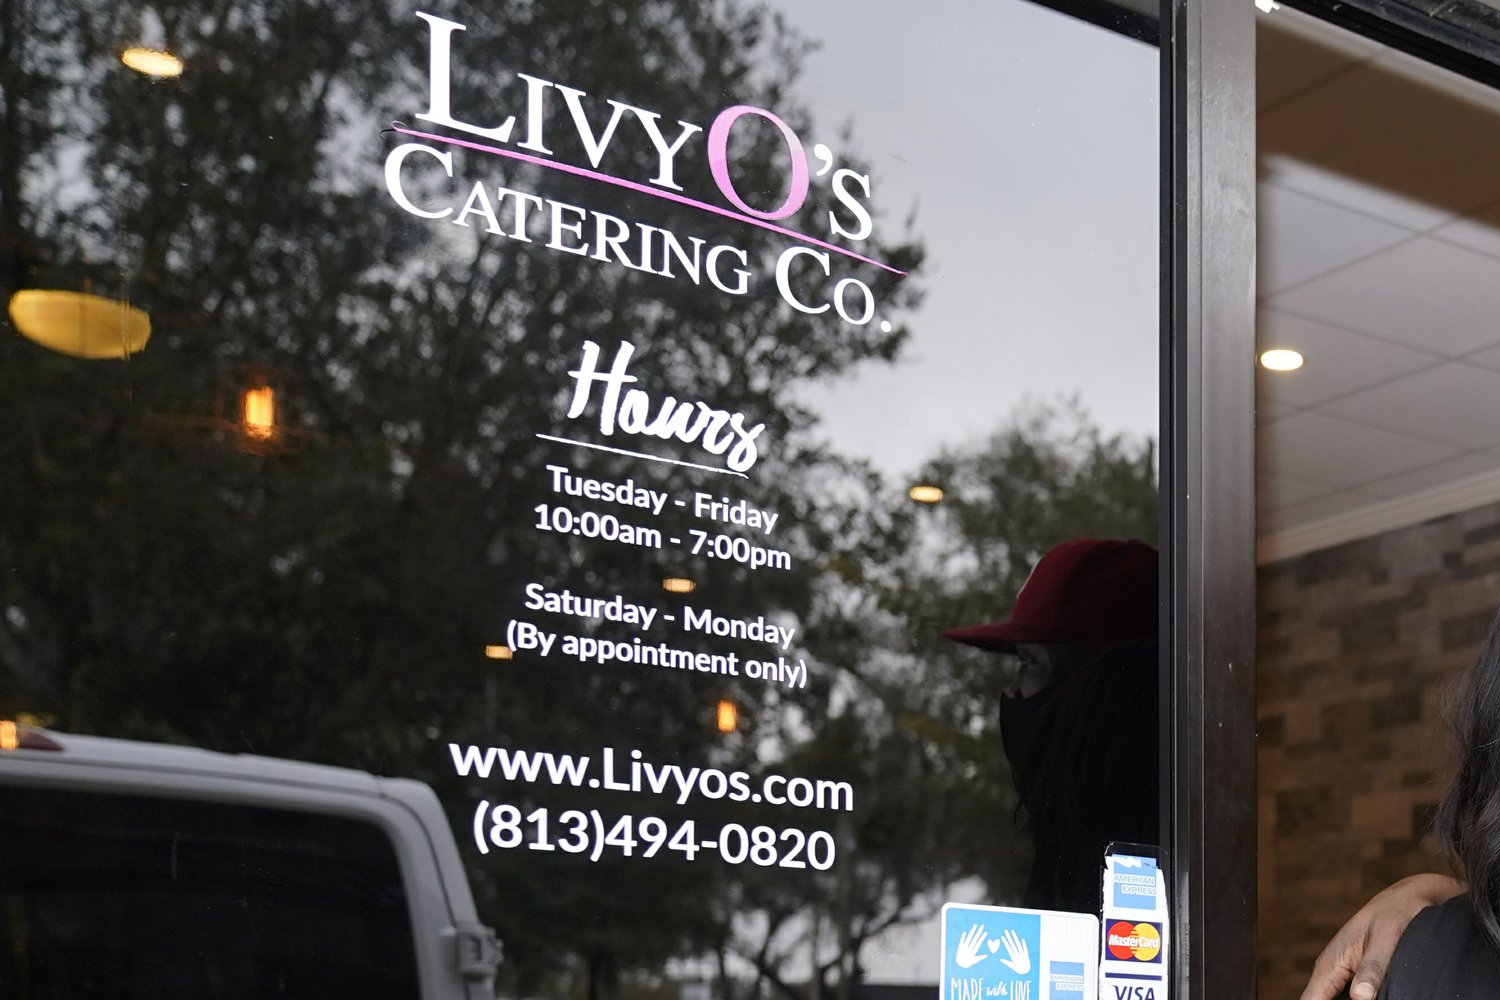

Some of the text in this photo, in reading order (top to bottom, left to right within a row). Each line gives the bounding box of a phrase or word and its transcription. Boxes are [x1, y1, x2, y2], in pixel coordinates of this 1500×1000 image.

[384, 143, 752, 295] CATERING
[567, 340, 766, 472] Hours
[546, 464, 668, 516] Tuesday
[694, 492, 779, 535] Friday
[534, 503, 662, 548] 10:00am
[689, 530, 792, 571] 7:00pm
[524, 583, 656, 628] Saturday
[683, 605, 796, 650] Monday
[506, 619, 808, 688] (By appointment only)
[448, 742, 855, 812] www.Livyos.com
[473, 800, 836, 871] (813)494-0820
[1114, 875, 1154, 885] AMERICAN
[1122, 886, 1158, 895] EXPRESS
[1108, 934, 1159, 949] MasterCard
